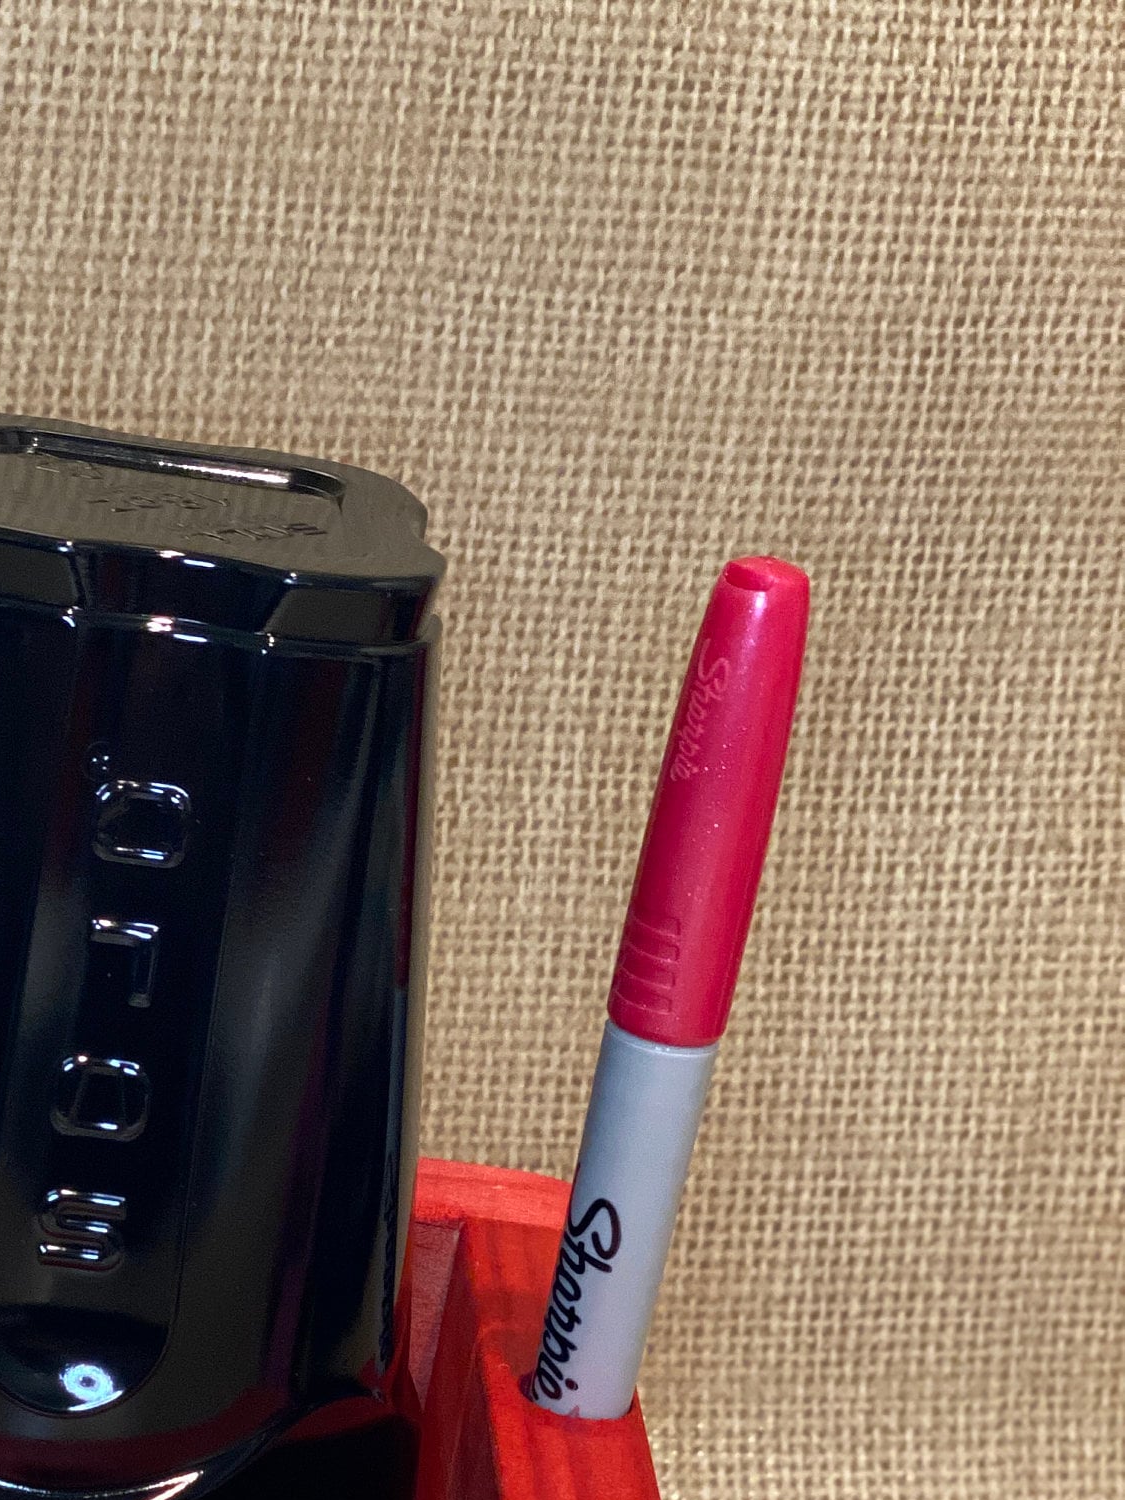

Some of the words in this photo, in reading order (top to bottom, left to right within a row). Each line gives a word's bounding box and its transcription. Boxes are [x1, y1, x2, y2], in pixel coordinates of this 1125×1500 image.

[670, 637, 731, 783] Sharpie
[35, 778, 191, 1273] SOLO
[530, 1162, 622, 1401] Sharpie
